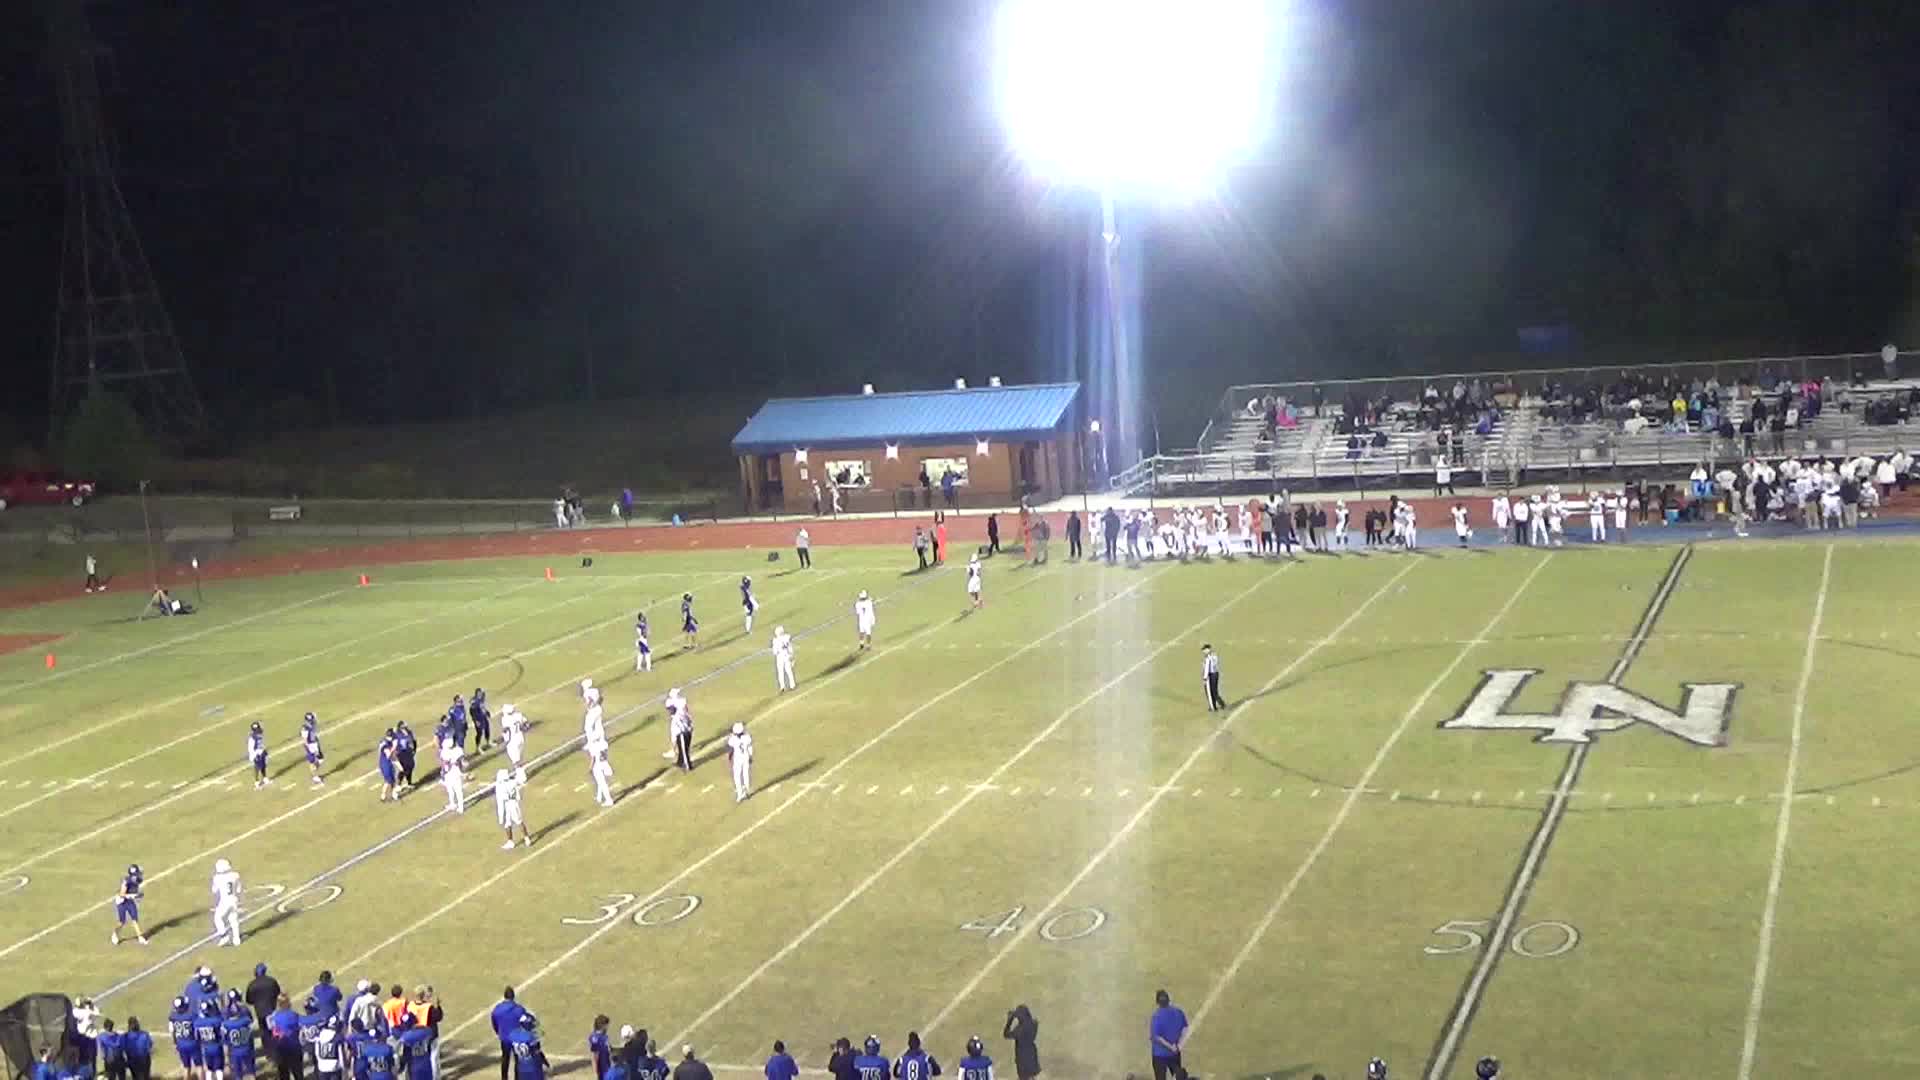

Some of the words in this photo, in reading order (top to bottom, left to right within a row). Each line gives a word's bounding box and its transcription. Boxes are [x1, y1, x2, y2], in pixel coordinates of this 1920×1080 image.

[560, 893, 702, 926] 30
[959, 904, 1107, 940] 40
[1423, 919, 1580, 959] 50
[907, 1059, 919, 1080] 8
